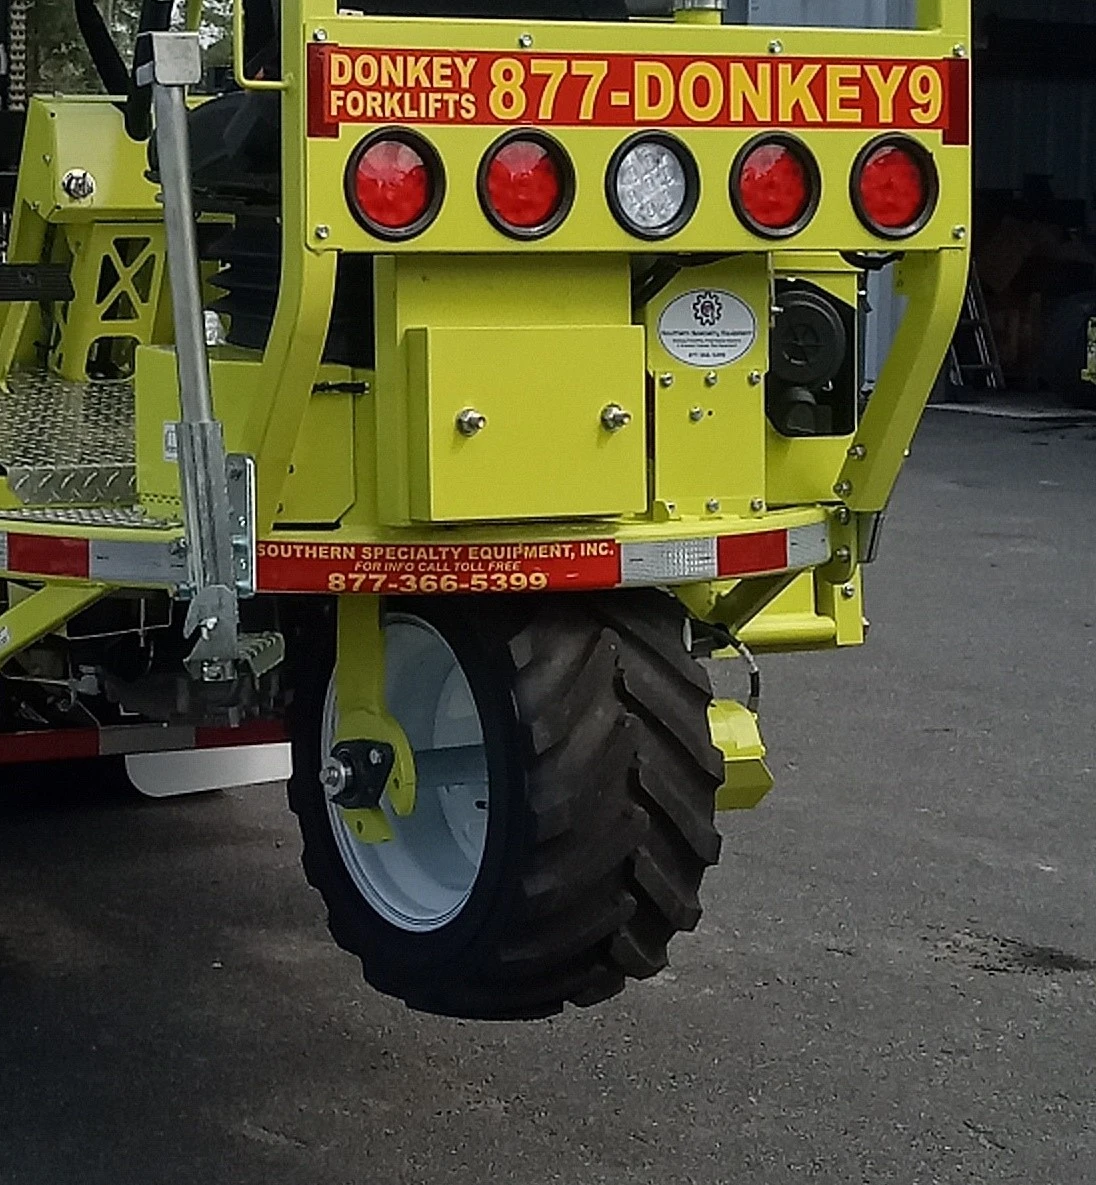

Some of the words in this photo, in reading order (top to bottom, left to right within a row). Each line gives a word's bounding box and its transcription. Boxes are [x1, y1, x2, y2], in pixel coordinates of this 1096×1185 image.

[330, 53, 478, 89] DONKEY
[488, 58, 943, 124] 877-DONKEY9
[330, 90, 477, 120] FORKLIFTS
[256, 544, 356, 560] SOUTHERN
[361, 546, 462, 560] SPECIALTY
[468, 543, 576, 560] EQUIPMENT,
[580, 542, 614, 556] INC.
[354, 562, 382, 572] FOR
[384, 562, 414, 572] INFO
[418, 562, 452, 572] CALL
[455, 561, 487, 572] TOLL
[488, 560, 522, 571] FREE
[328, 572, 548, 592] 877-366-5399
